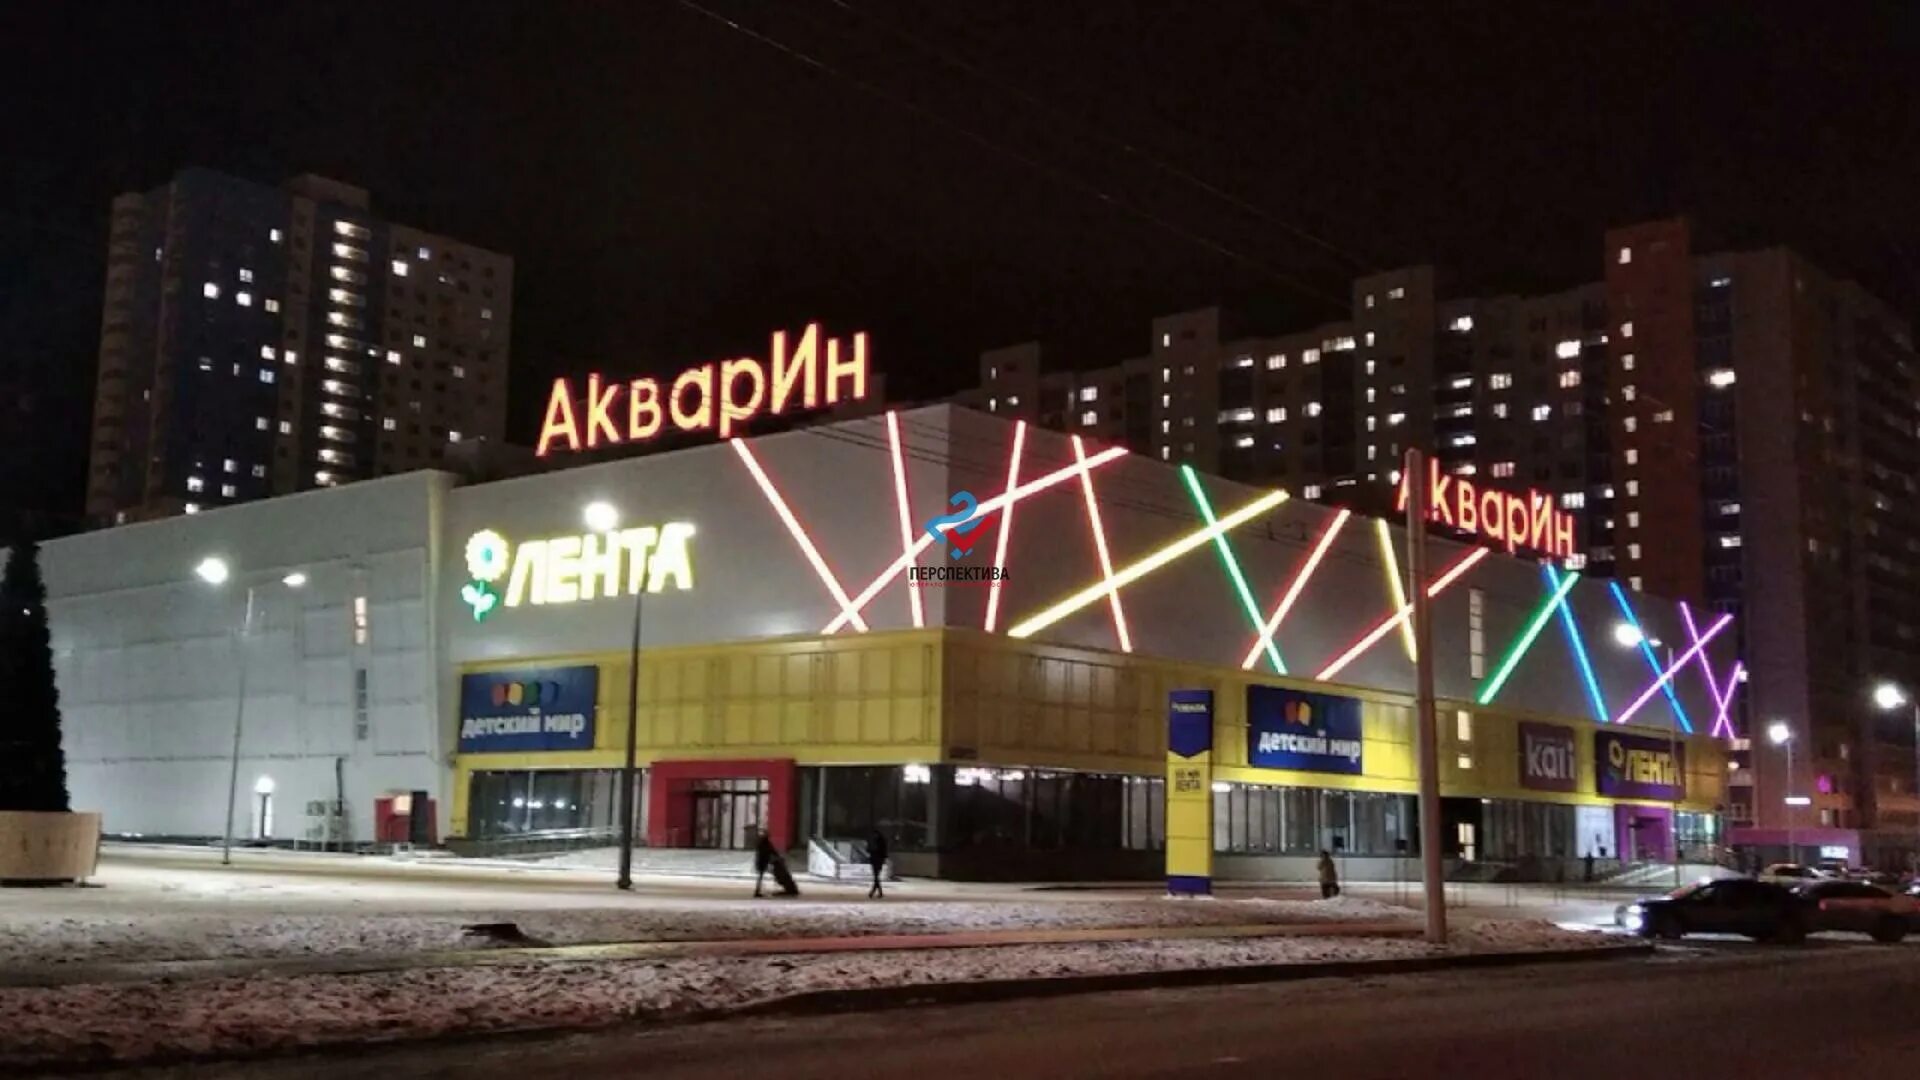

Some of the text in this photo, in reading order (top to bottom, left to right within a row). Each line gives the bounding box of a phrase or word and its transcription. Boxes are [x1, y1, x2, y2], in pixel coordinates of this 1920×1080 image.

[503, 521, 696, 608] ЛЕНТА
[461, 707, 585, 739] детский мир
[1258, 730, 1361, 764] детский мир
[1624, 748, 1682, 787] ЛЕНТА
